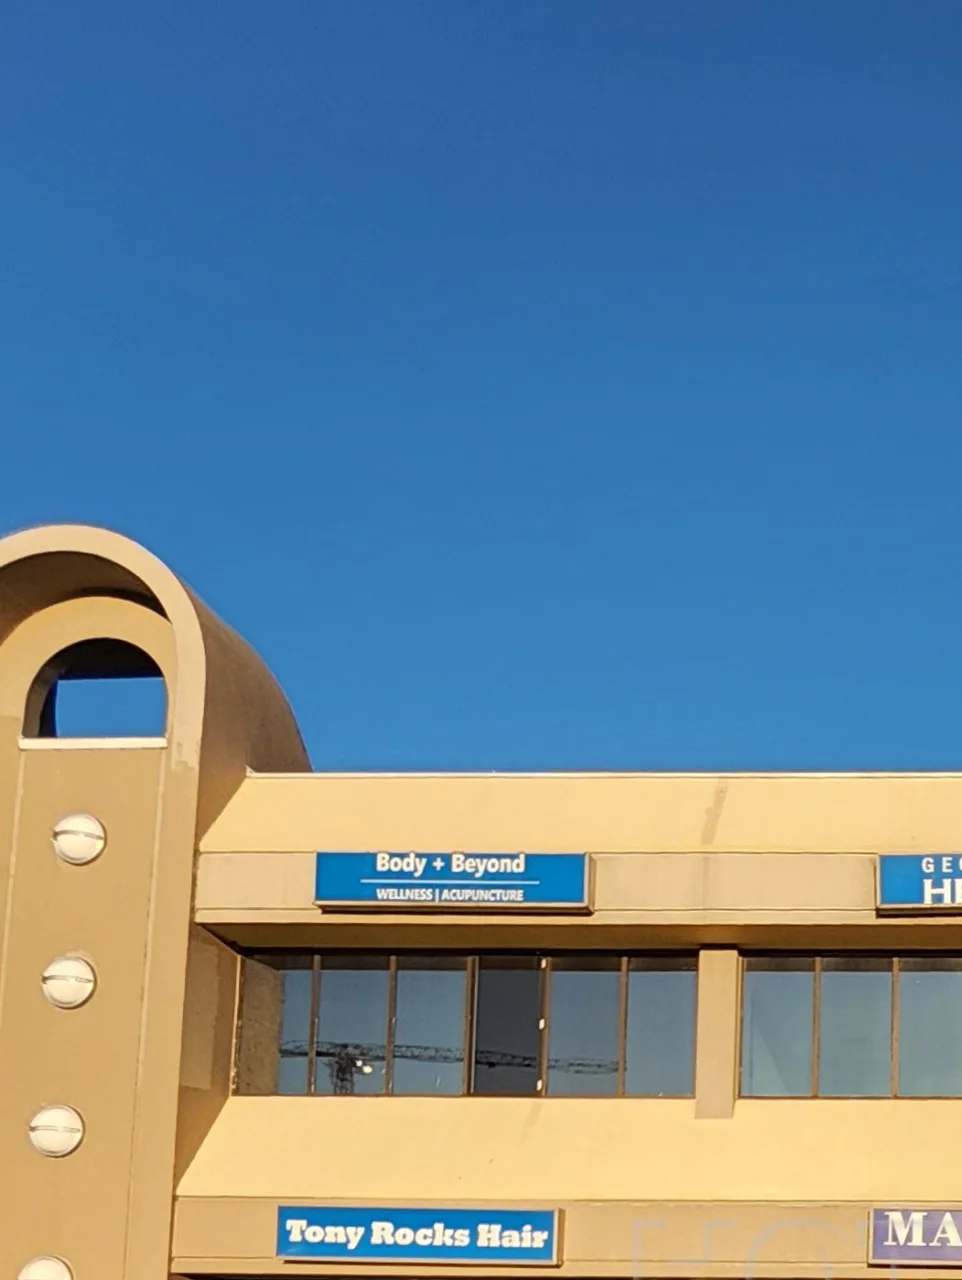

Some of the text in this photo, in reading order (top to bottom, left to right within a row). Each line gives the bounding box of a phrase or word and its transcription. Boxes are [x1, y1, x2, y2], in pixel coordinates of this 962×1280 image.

[376, 852, 427, 877] Body
[451, 852, 525, 878] Beyond
[376, 888, 524, 902] WELLNESS ACUPUNCTURE
[286, 1220, 548, 1249] Tony Rocks Hair
